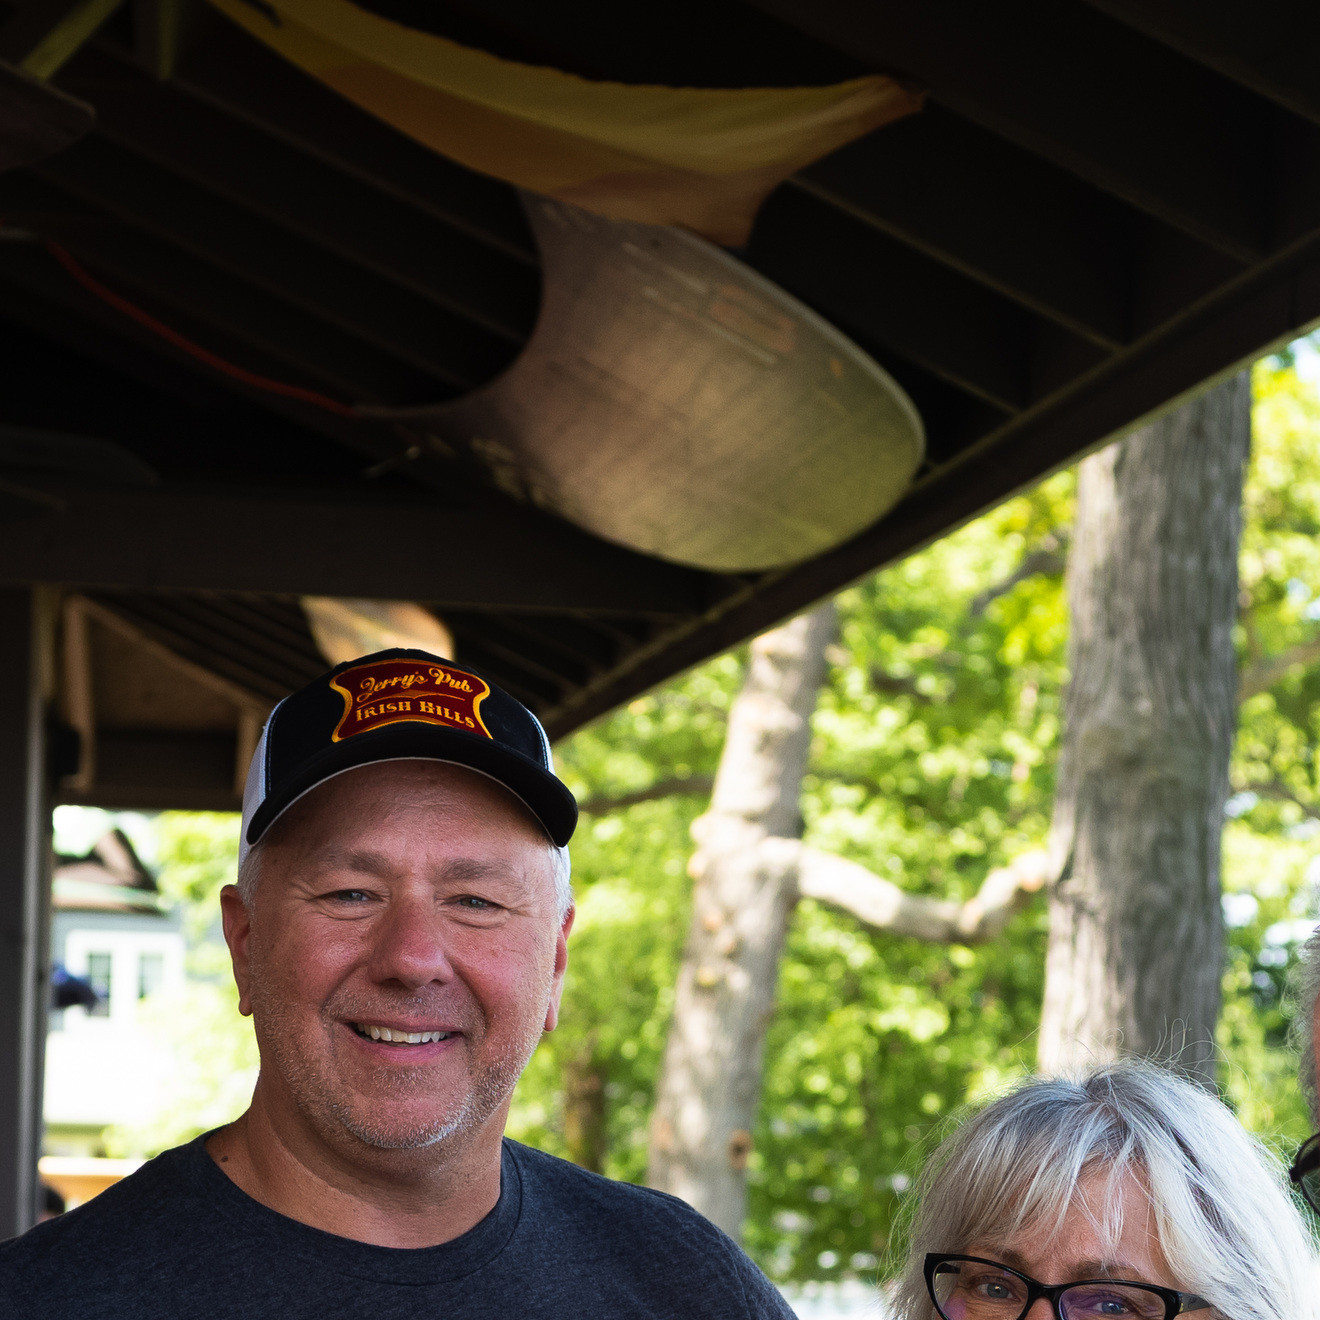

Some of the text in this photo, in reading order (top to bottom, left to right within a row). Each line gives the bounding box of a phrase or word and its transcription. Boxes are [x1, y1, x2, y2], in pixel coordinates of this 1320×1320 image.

[356, 667, 474, 703] Jerry's Pub
[356, 700, 476, 729] IRISH HILLS
